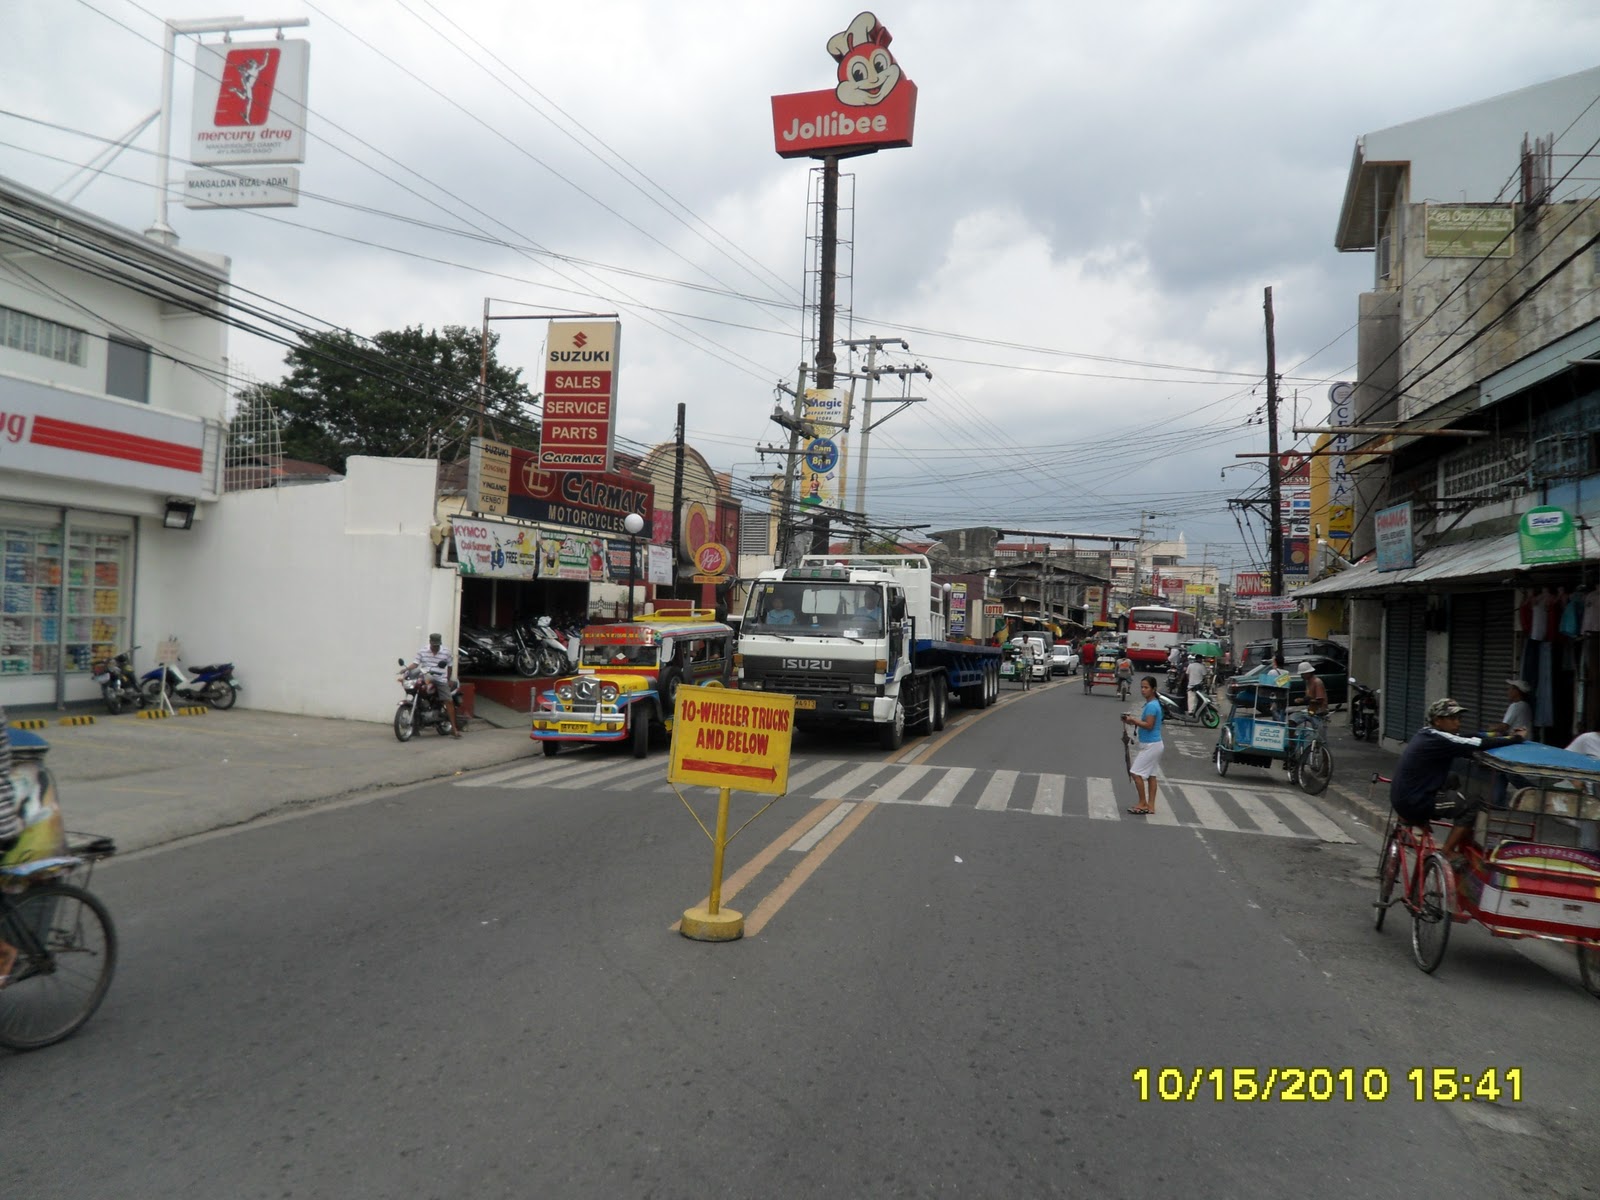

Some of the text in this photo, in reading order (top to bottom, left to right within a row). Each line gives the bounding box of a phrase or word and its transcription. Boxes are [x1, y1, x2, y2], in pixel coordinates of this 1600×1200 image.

[782, 110, 888, 141] Jollibee
[197, 128, 292, 142] mercury drug
[188, 179, 237, 188] MANGALDAN
[550, 350, 610, 362] SUZUKI
[555, 376, 601, 389] SALES
[546, 401, 607, 414] SERVICE
[551, 426, 598, 440] PARTS
[485, 444, 509, 458] SUZUKI
[541, 451, 606, 465] CARMAK
[482, 481, 507, 492] YINGANG
[562, 471, 649, 517] CARMAK
[547, 504, 626, 533] MOTORCYCLES
[454, 525, 488, 539] KYMCO
[985, 605, 1003, 614] LOTTO
[782, 658, 832, 671] ISUZU
[682, 699, 790, 733] 10-WHEELER TRUCKS
[695, 727, 770, 756] AND BELOW
